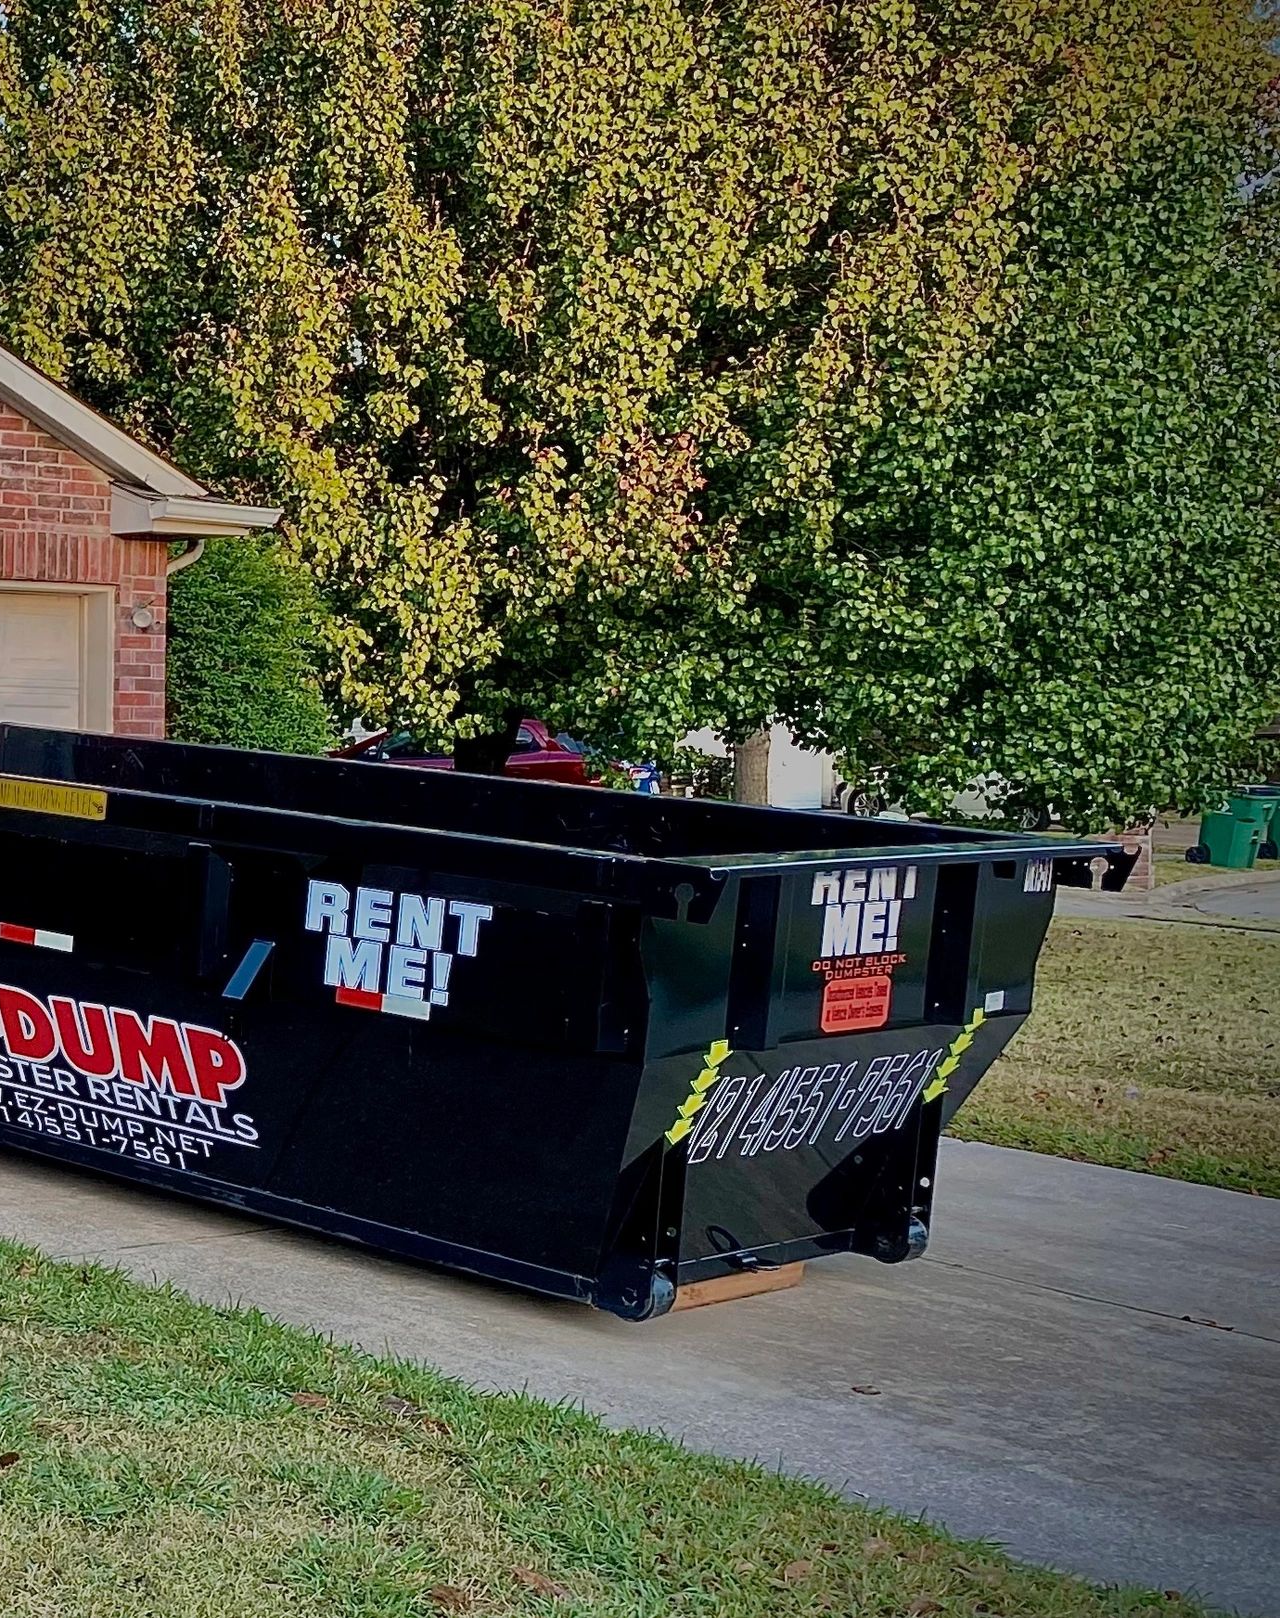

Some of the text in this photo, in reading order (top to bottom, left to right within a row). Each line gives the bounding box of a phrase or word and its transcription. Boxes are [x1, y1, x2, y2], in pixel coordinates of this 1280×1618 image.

[305, 879, 494, 957] RENT
[820, 900, 902, 957] ME!
[324, 934, 453, 1007] ME!
[812, 954, 907, 971] DO NOT BLOCK
[825, 965, 893, 981] DUMPSTER
[88, 1077, 260, 1141] RENTALS
[687, 1049, 943, 1165] (214)551-7561
